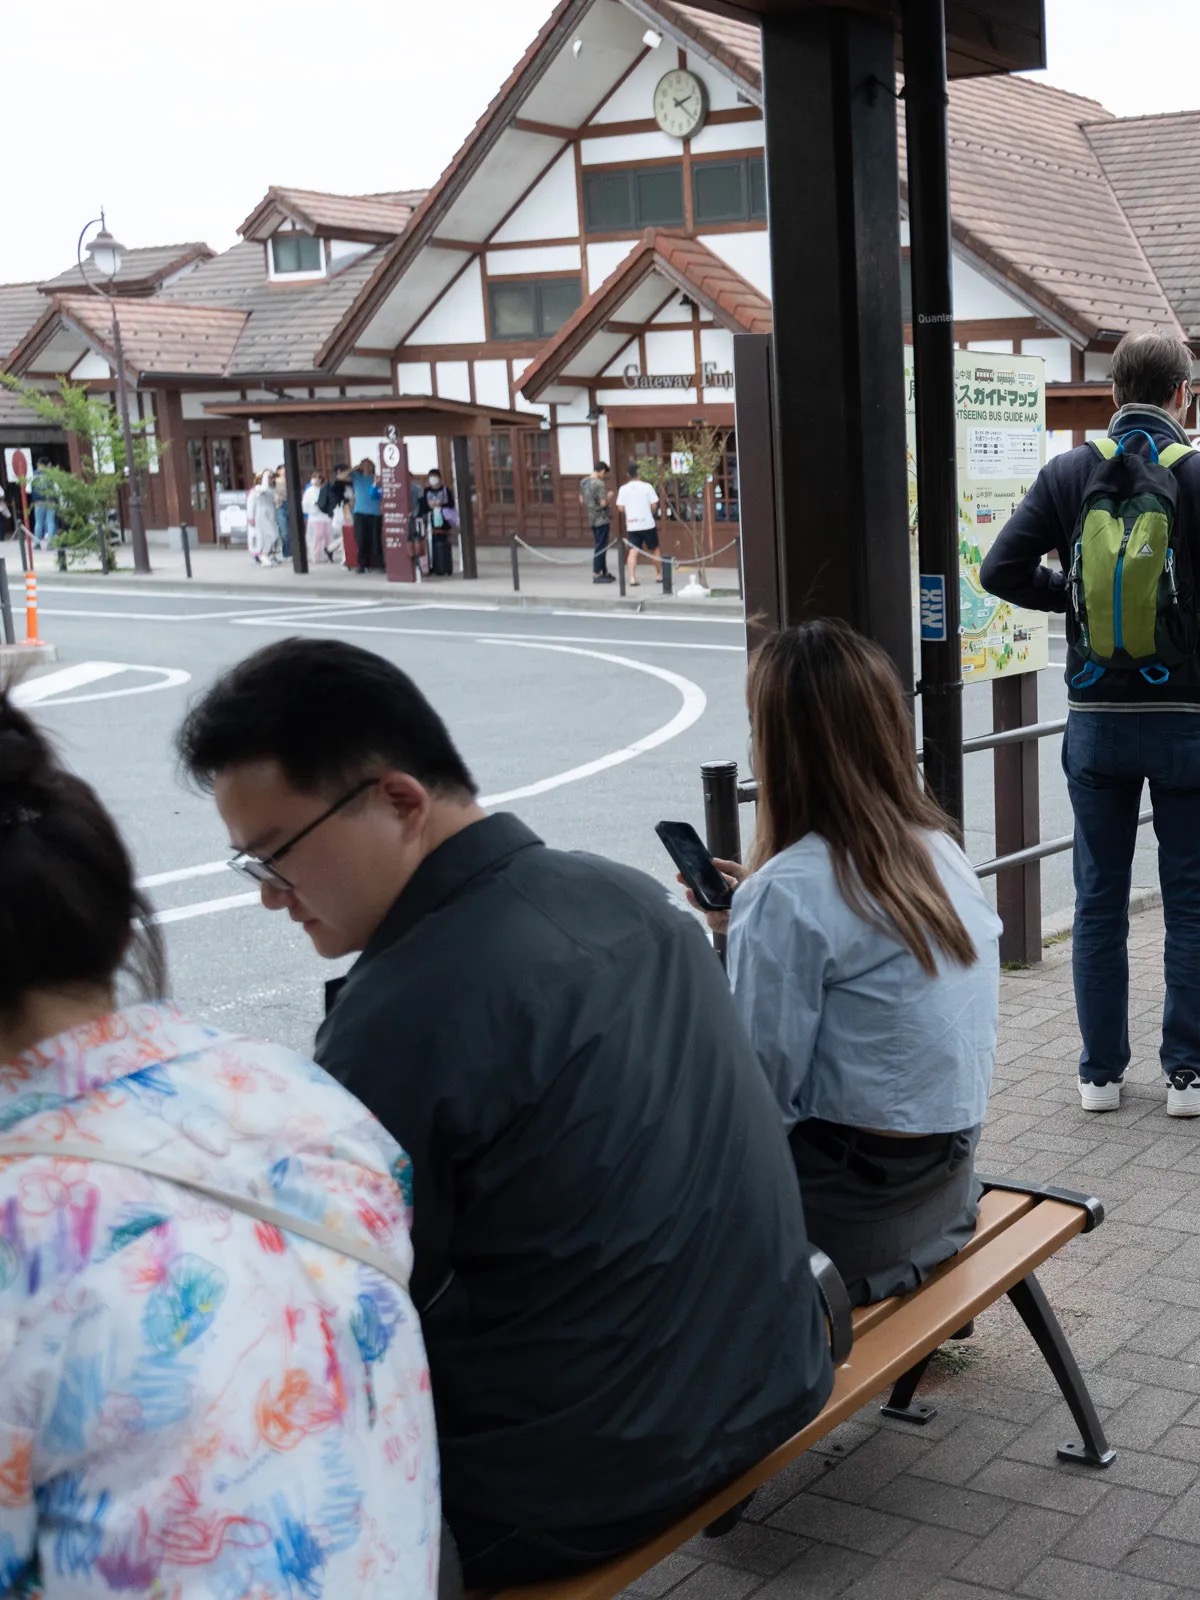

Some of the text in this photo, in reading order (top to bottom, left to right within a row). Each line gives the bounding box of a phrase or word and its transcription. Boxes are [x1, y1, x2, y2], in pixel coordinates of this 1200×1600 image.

[623, 363, 692, 392] Gateway
[989, 411, 1002, 421] BUS
[1003, 412, 1022, 422] GUIDE
[1024, 413, 1038, 423] MAP
